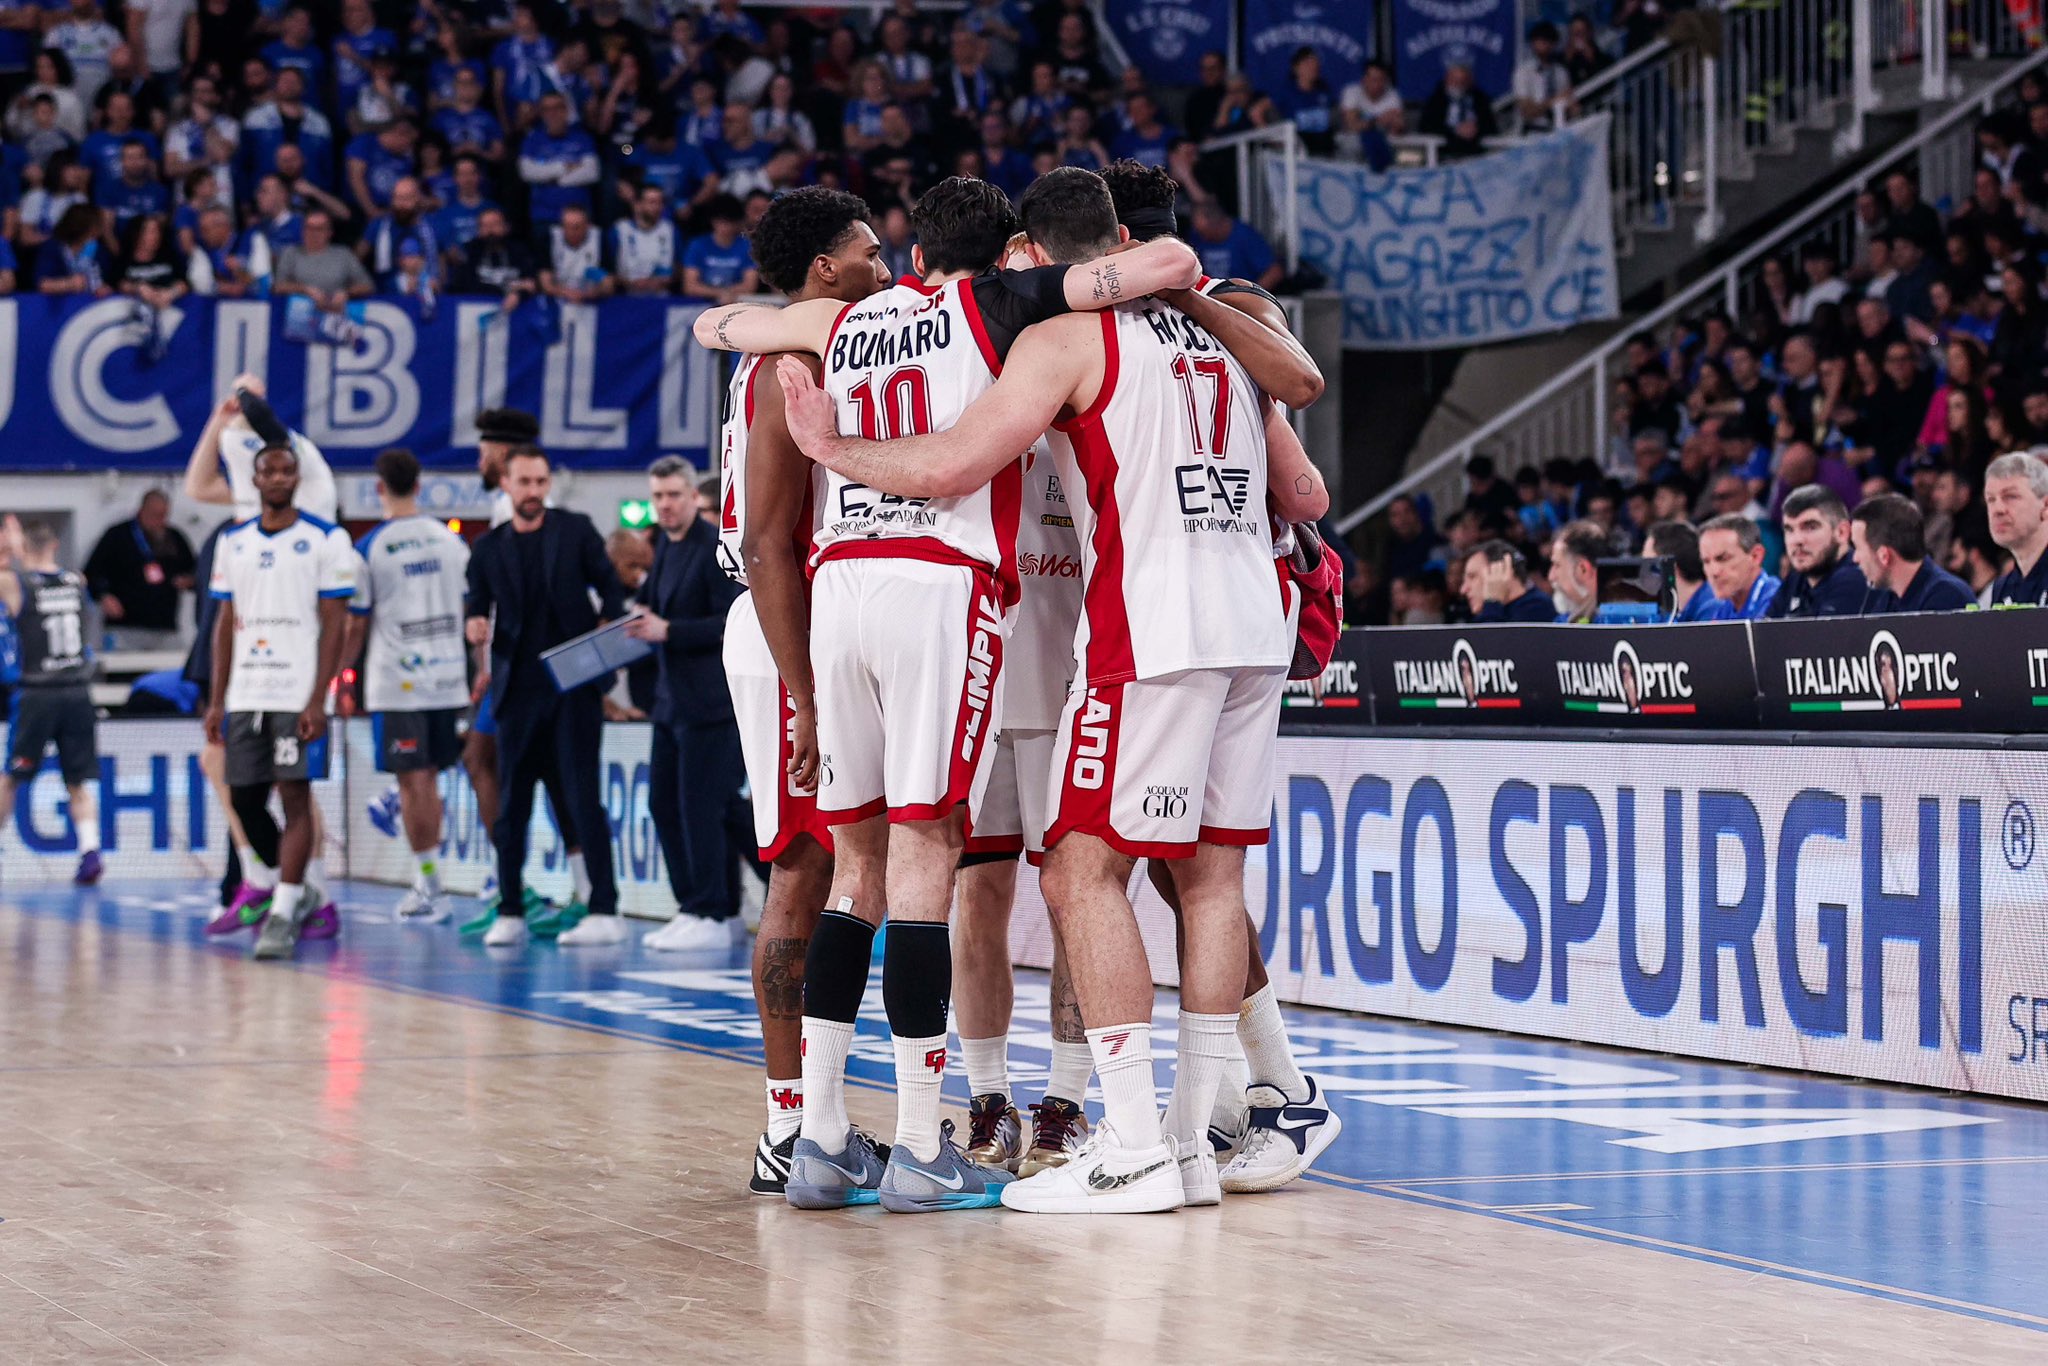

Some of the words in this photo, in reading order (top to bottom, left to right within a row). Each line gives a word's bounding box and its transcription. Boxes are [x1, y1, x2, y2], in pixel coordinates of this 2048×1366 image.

[847, 364, 934, 442] 10
[1169, 352, 1234, 460] 17
[1393, 660, 1456, 695] ITALIAN
[1556, 660, 1617, 698] ITALIAN
[1785, 656, 1870, 696] ITALIAN
[1144, 786, 1177, 796] ACQUA
[1178, 787, 1190, 796] DI
[1489, 777, 1982, 1054] SPURGHI
